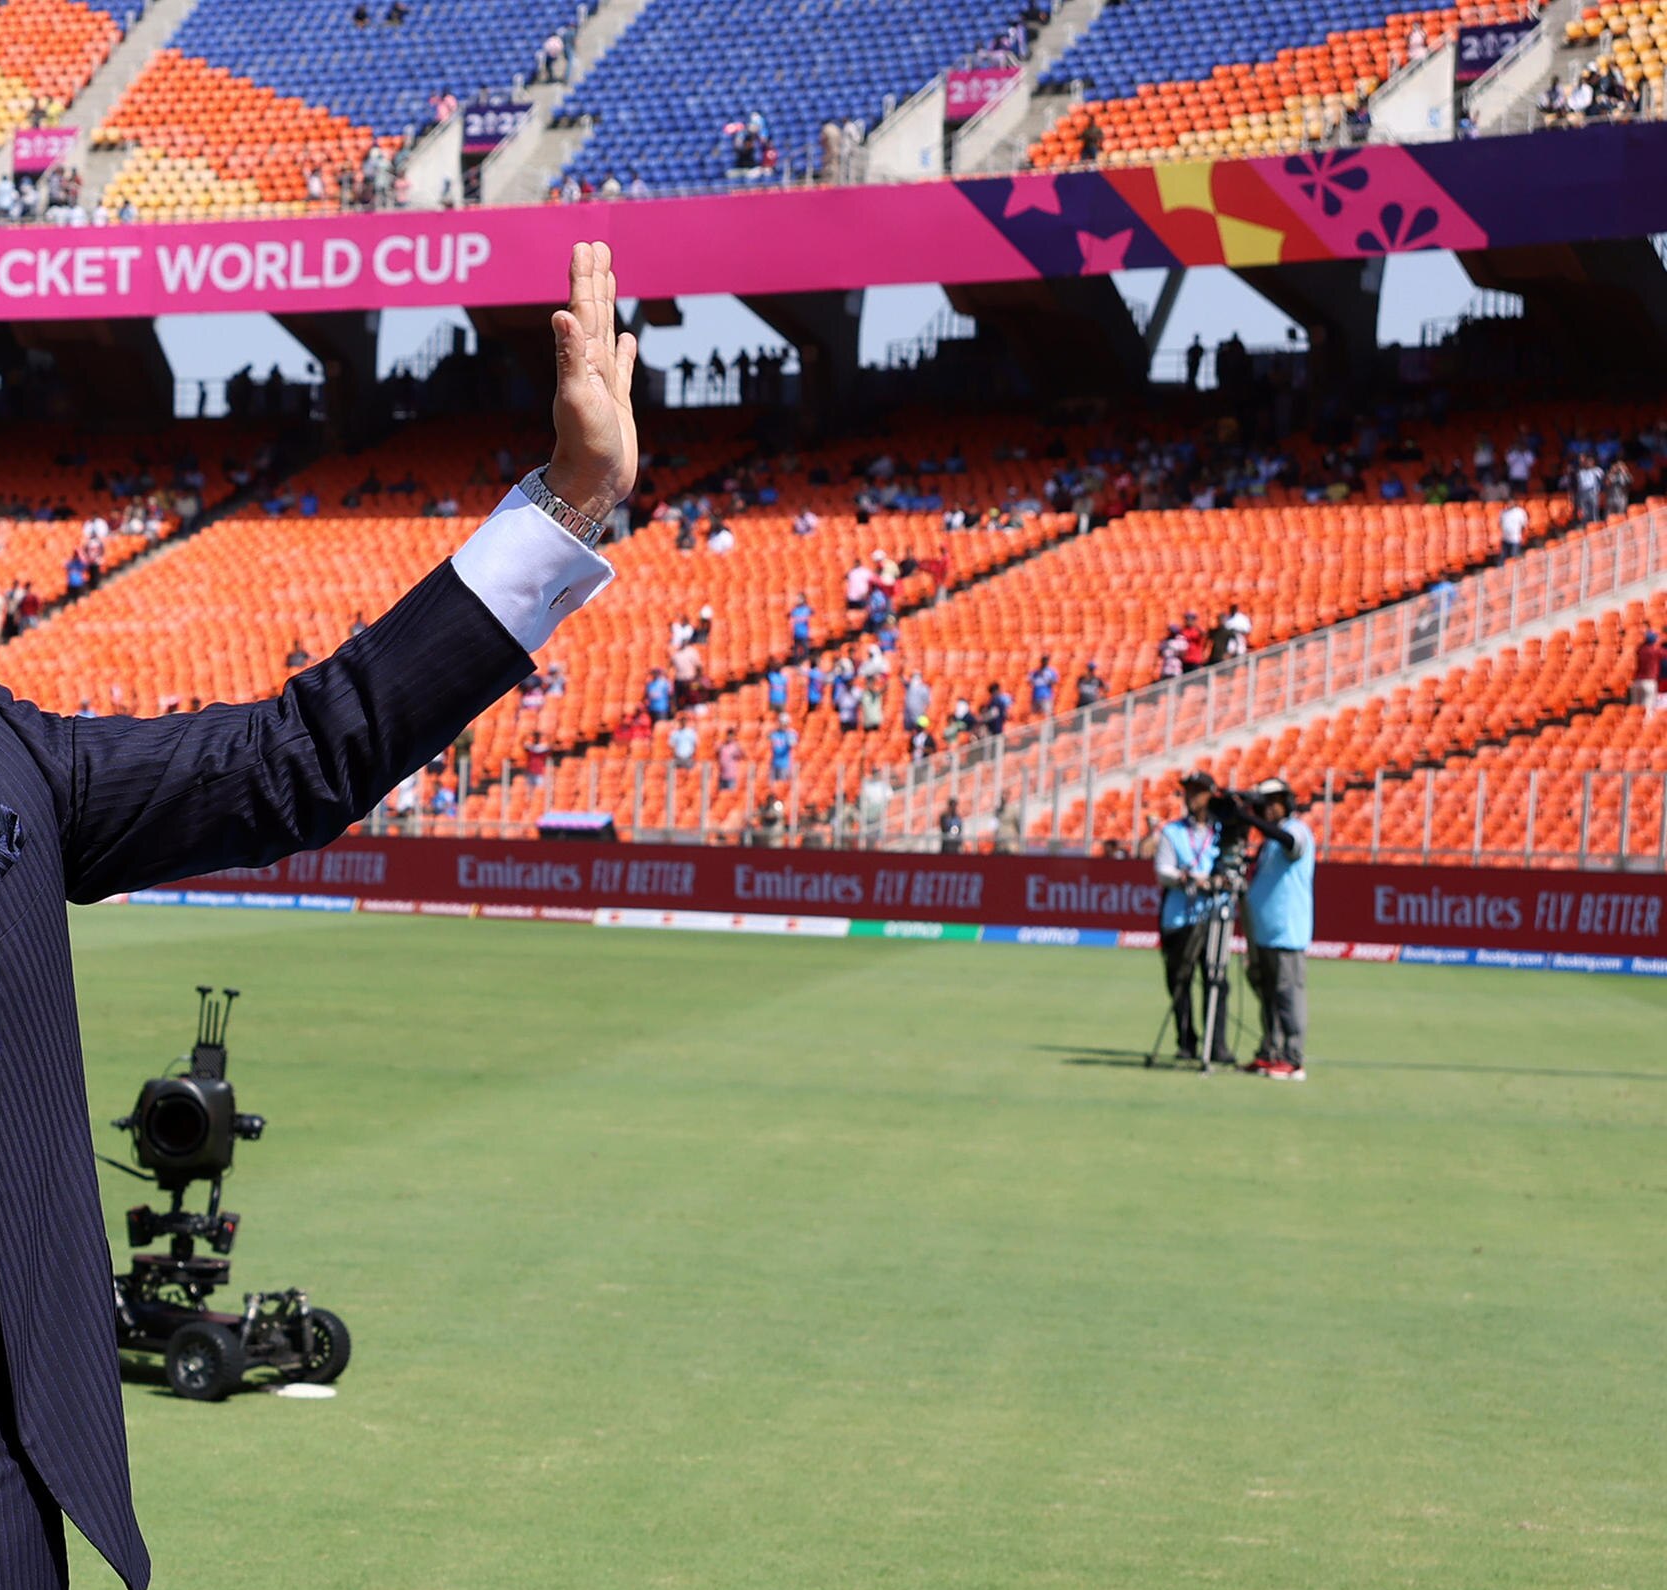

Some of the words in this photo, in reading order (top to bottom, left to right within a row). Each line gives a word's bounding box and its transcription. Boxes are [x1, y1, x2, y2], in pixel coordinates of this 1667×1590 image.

[156, 238, 362, 294] WORLD
[372, 233, 491, 286] CUP
[322, 853, 386, 884] BETTER
[457, 854, 581, 891] Emirates
[591, 859, 624, 892] FLY
[626, 861, 695, 896] BETTER
[734, 864, 863, 903] Emirates
[873, 870, 909, 906] FLY
[909, 871, 984, 908] BETTER
[1374, 885, 1523, 929] Emirates
[1535, 891, 1576, 932] FLY
[1578, 893, 1662, 936] BETTER
